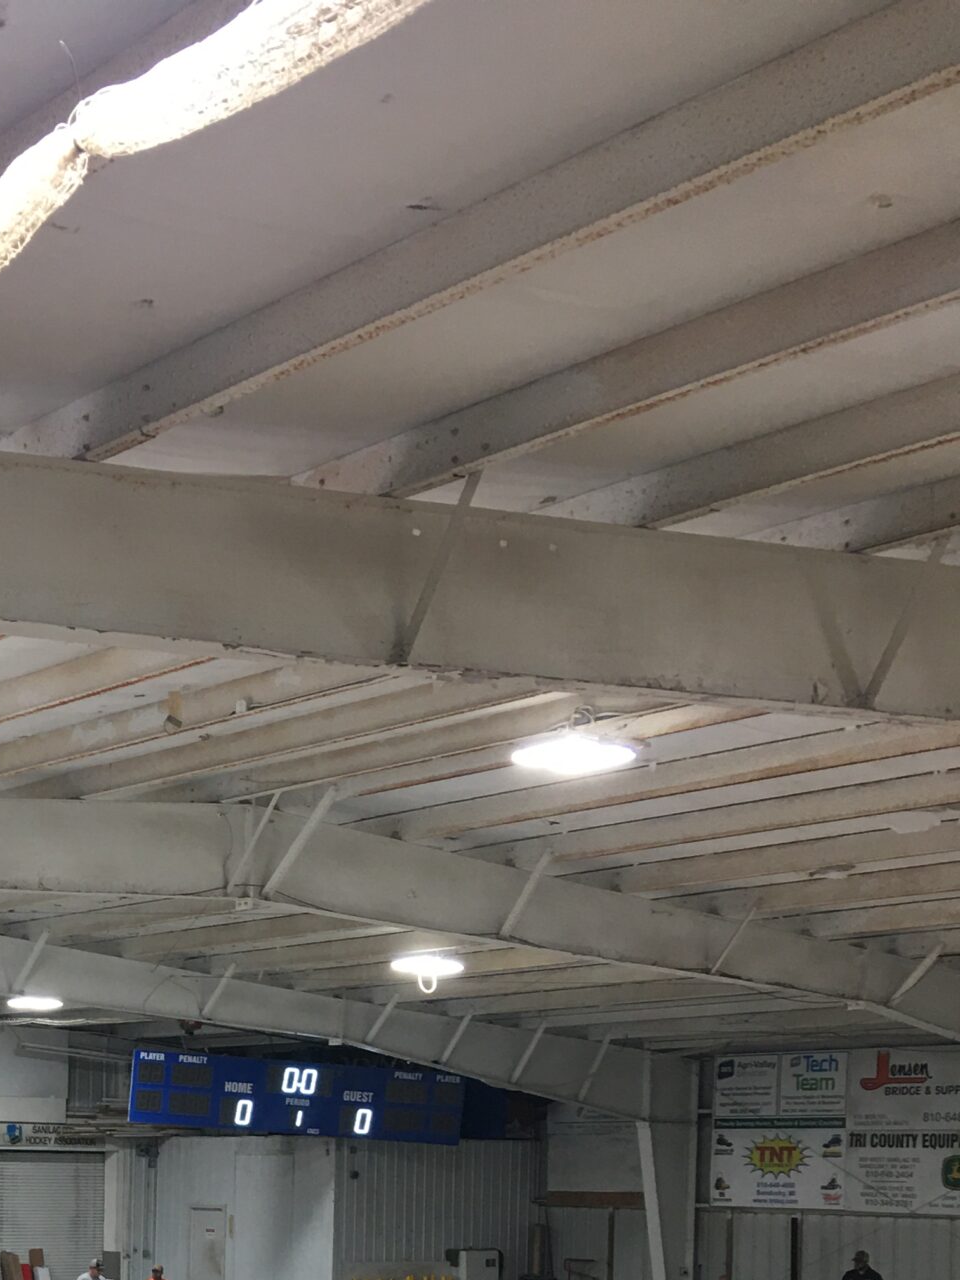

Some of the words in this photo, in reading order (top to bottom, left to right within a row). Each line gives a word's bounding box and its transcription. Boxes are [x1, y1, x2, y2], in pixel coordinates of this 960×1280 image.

[140, 1052, 165, 1062] PLAYER
[179, 1055, 208, 1065] PENALTY
[803, 1055, 839, 1074] Tech
[394, 1071, 424, 1082] PENALTY
[436, 1075, 461, 1085] PLAYER
[793, 1074, 836, 1092] Team
[224, 1082, 253, 1094] HOME
[884, 1087, 921, 1097] BRIDGE
[925, 1086, 931, 1096] &
[285, 1098, 311, 1107] PERIOD
[343, 1091, 375, 1104] GUEST
[234, 1099, 254, 1127] 0
[353, 1108, 373, 1136] 0
[25, 1136, 52, 1146] HOCKEY
[53, 1137, 98, 1147] ASSOCIATION
[849, 1133, 867, 1148] TRI
[870, 1133, 918, 1149] COUNTY
[922, 1133, 960, 1150] EQUIP
[756, 1146, 796, 1164] TNT
